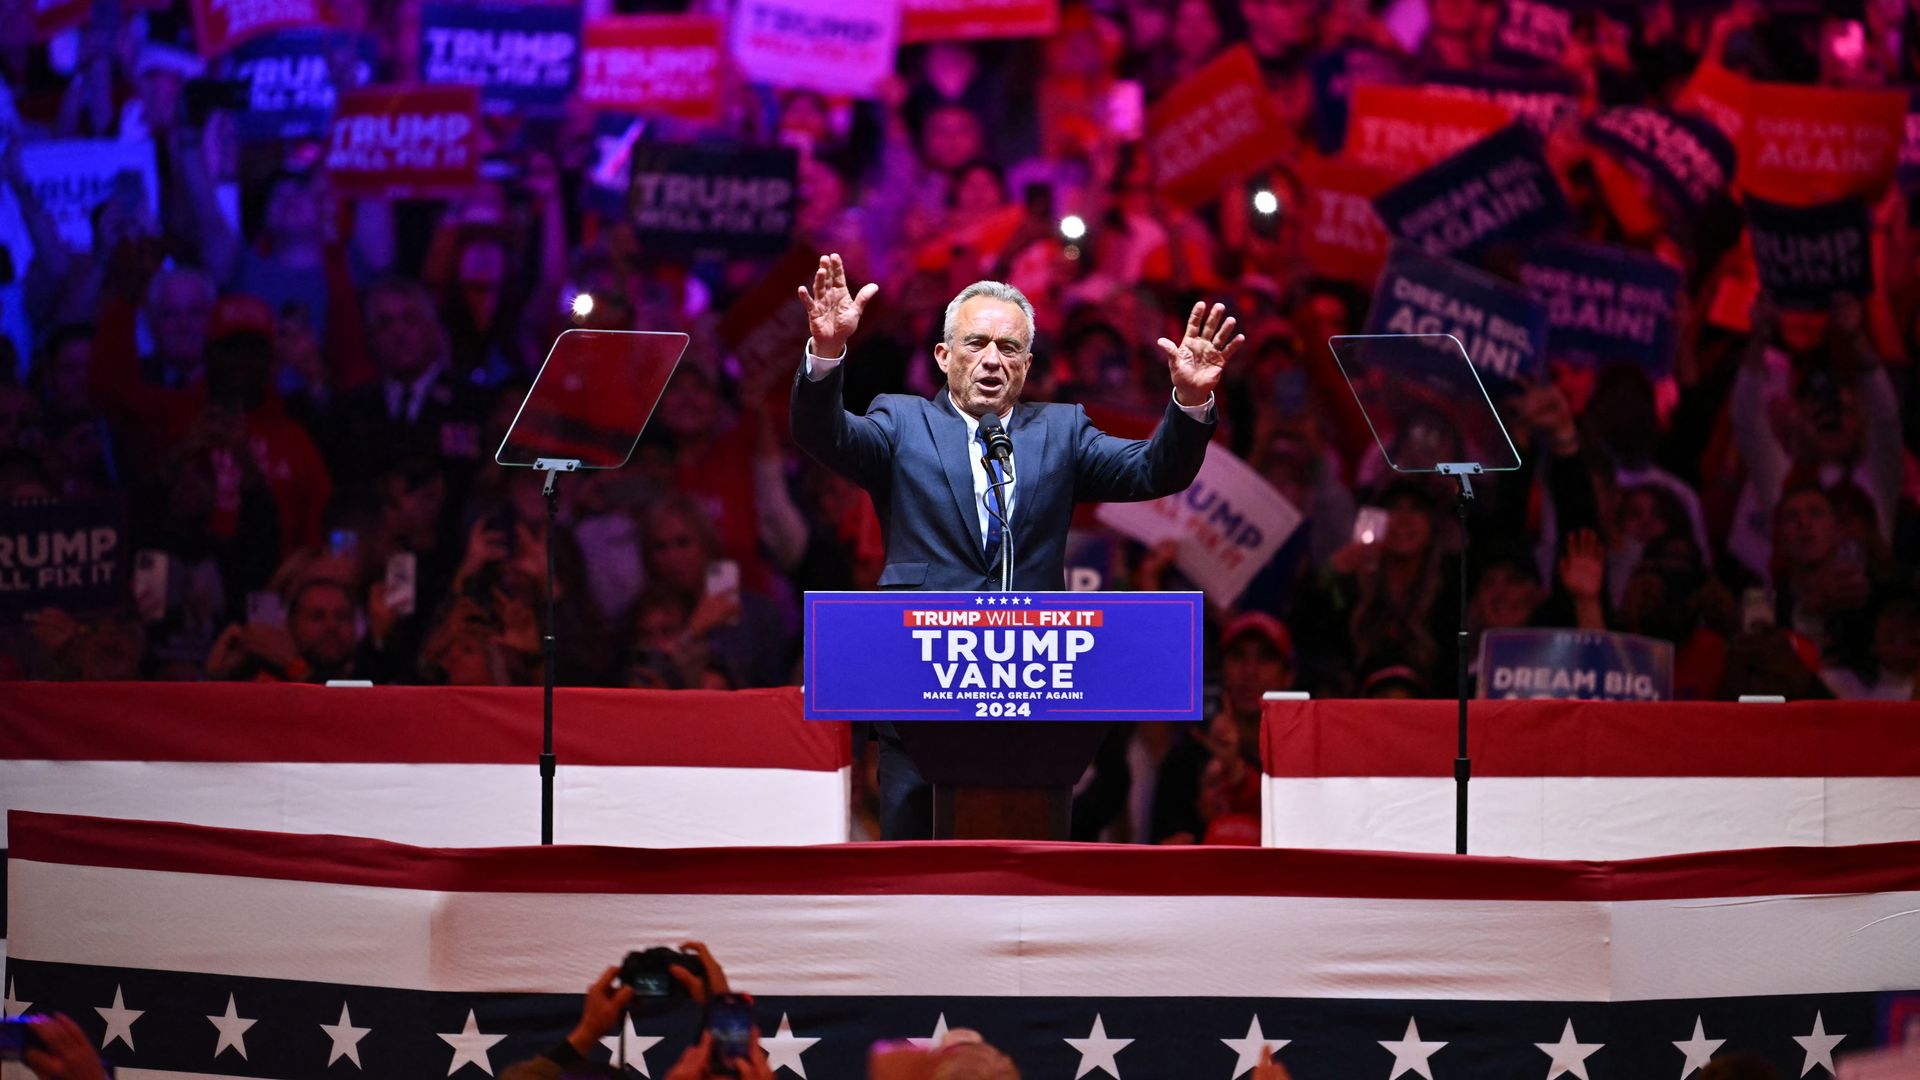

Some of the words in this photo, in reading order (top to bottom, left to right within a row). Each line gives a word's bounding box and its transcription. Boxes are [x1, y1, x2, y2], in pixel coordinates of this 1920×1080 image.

[426, 27, 577, 64] TRUMP
[331, 113, 472, 150] TRUMP
[636, 172, 793, 211] TRUMP
[1753, 225, 1861, 267] RUMP
[1393, 276, 1485, 331] DREAM
[1549, 291, 1659, 345] GAIN!
[1386, 303, 1521, 382] AGAIN!
[0, 525, 118, 567] RUMP
[38, 564, 83, 591] FIX
[91, 559, 117, 585] IT
[912, 611, 981, 626] TRUMP
[985, 611, 1034, 626] WILL
[1039, 611, 1072, 626] FIX
[1076, 611, 1095, 626] IT
[912, 629, 1095, 662] TRUMP
[932, 663, 1074, 689] VANCE
[1493, 666, 1598, 693] DREAM
[923, 692, 953, 700] MAKE
[956, 692, 1005, 700] AMERICA
[1008, 692, 1042, 700] GREAT
[1046, 692, 1084, 700] AGAIN!
[975, 702, 1031, 717] 2024
